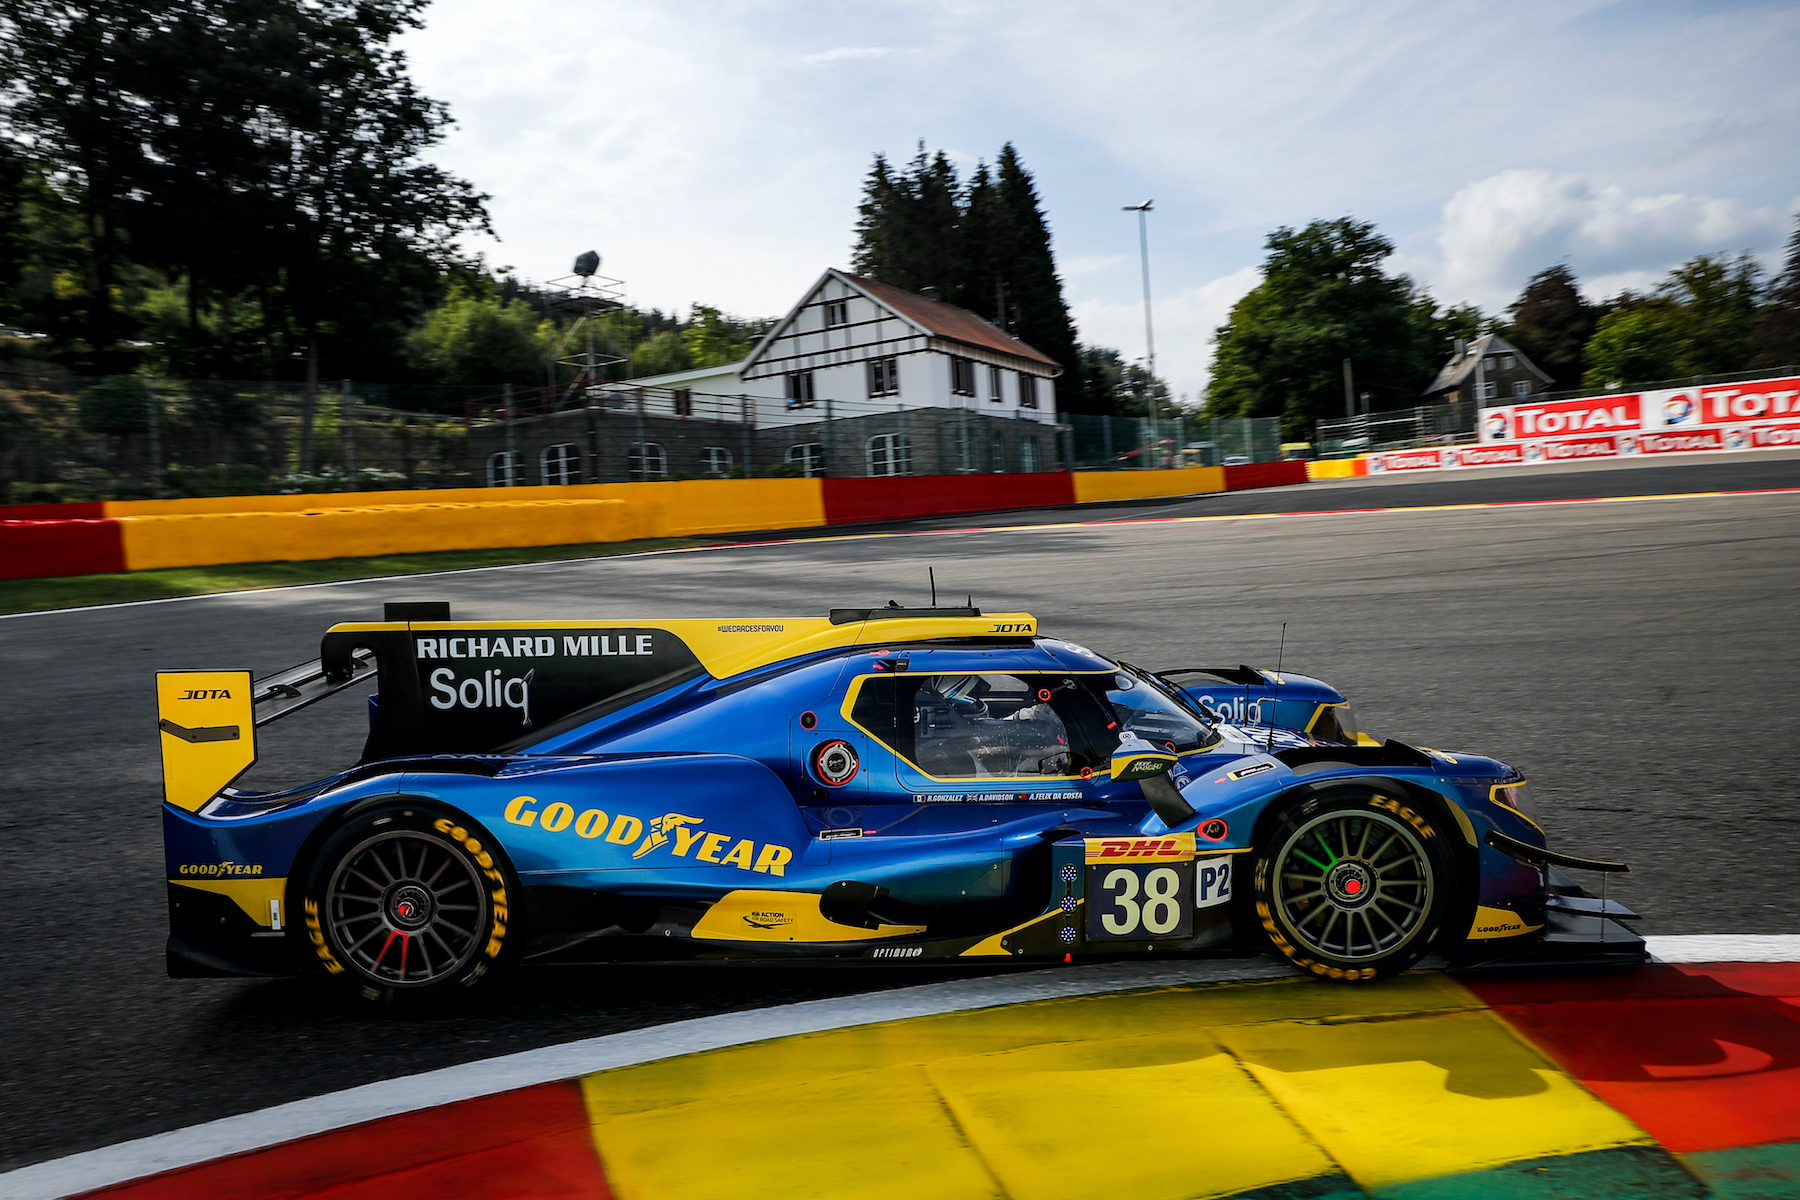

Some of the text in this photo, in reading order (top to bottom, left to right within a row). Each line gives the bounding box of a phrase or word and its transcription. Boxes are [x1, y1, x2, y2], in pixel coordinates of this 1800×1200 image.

[1702, 389, 1800, 418] TOT
[1515, 405, 1639, 434] TOTAL
[1638, 434, 1724, 451] TOTAL
[1749, 427, 1800, 444] TOT
[1458, 449, 1525, 464] TOTAL
[1543, 441, 1618, 458] TOTAL
[1383, 455, 1442, 469] TOTAL
[987, 623, 1032, 633] JOTA
[417, 634, 653, 659] RICHARD MILLE
[177, 689, 231, 700] JOTA
[430, 667, 534, 727] Soliq
[978, 793, 1015, 802] A.DAVIDSON
[1029, 792, 1083, 801] A.FELIX DA COSTA
[504, 796, 793, 877] GOODYEAR
[1099, 840, 1182, 858] DHL
[179, 863, 263, 876] GOODYEAR
[1201, 863, 1230, 901] P2
[1101, 868, 1181, 935] 38
